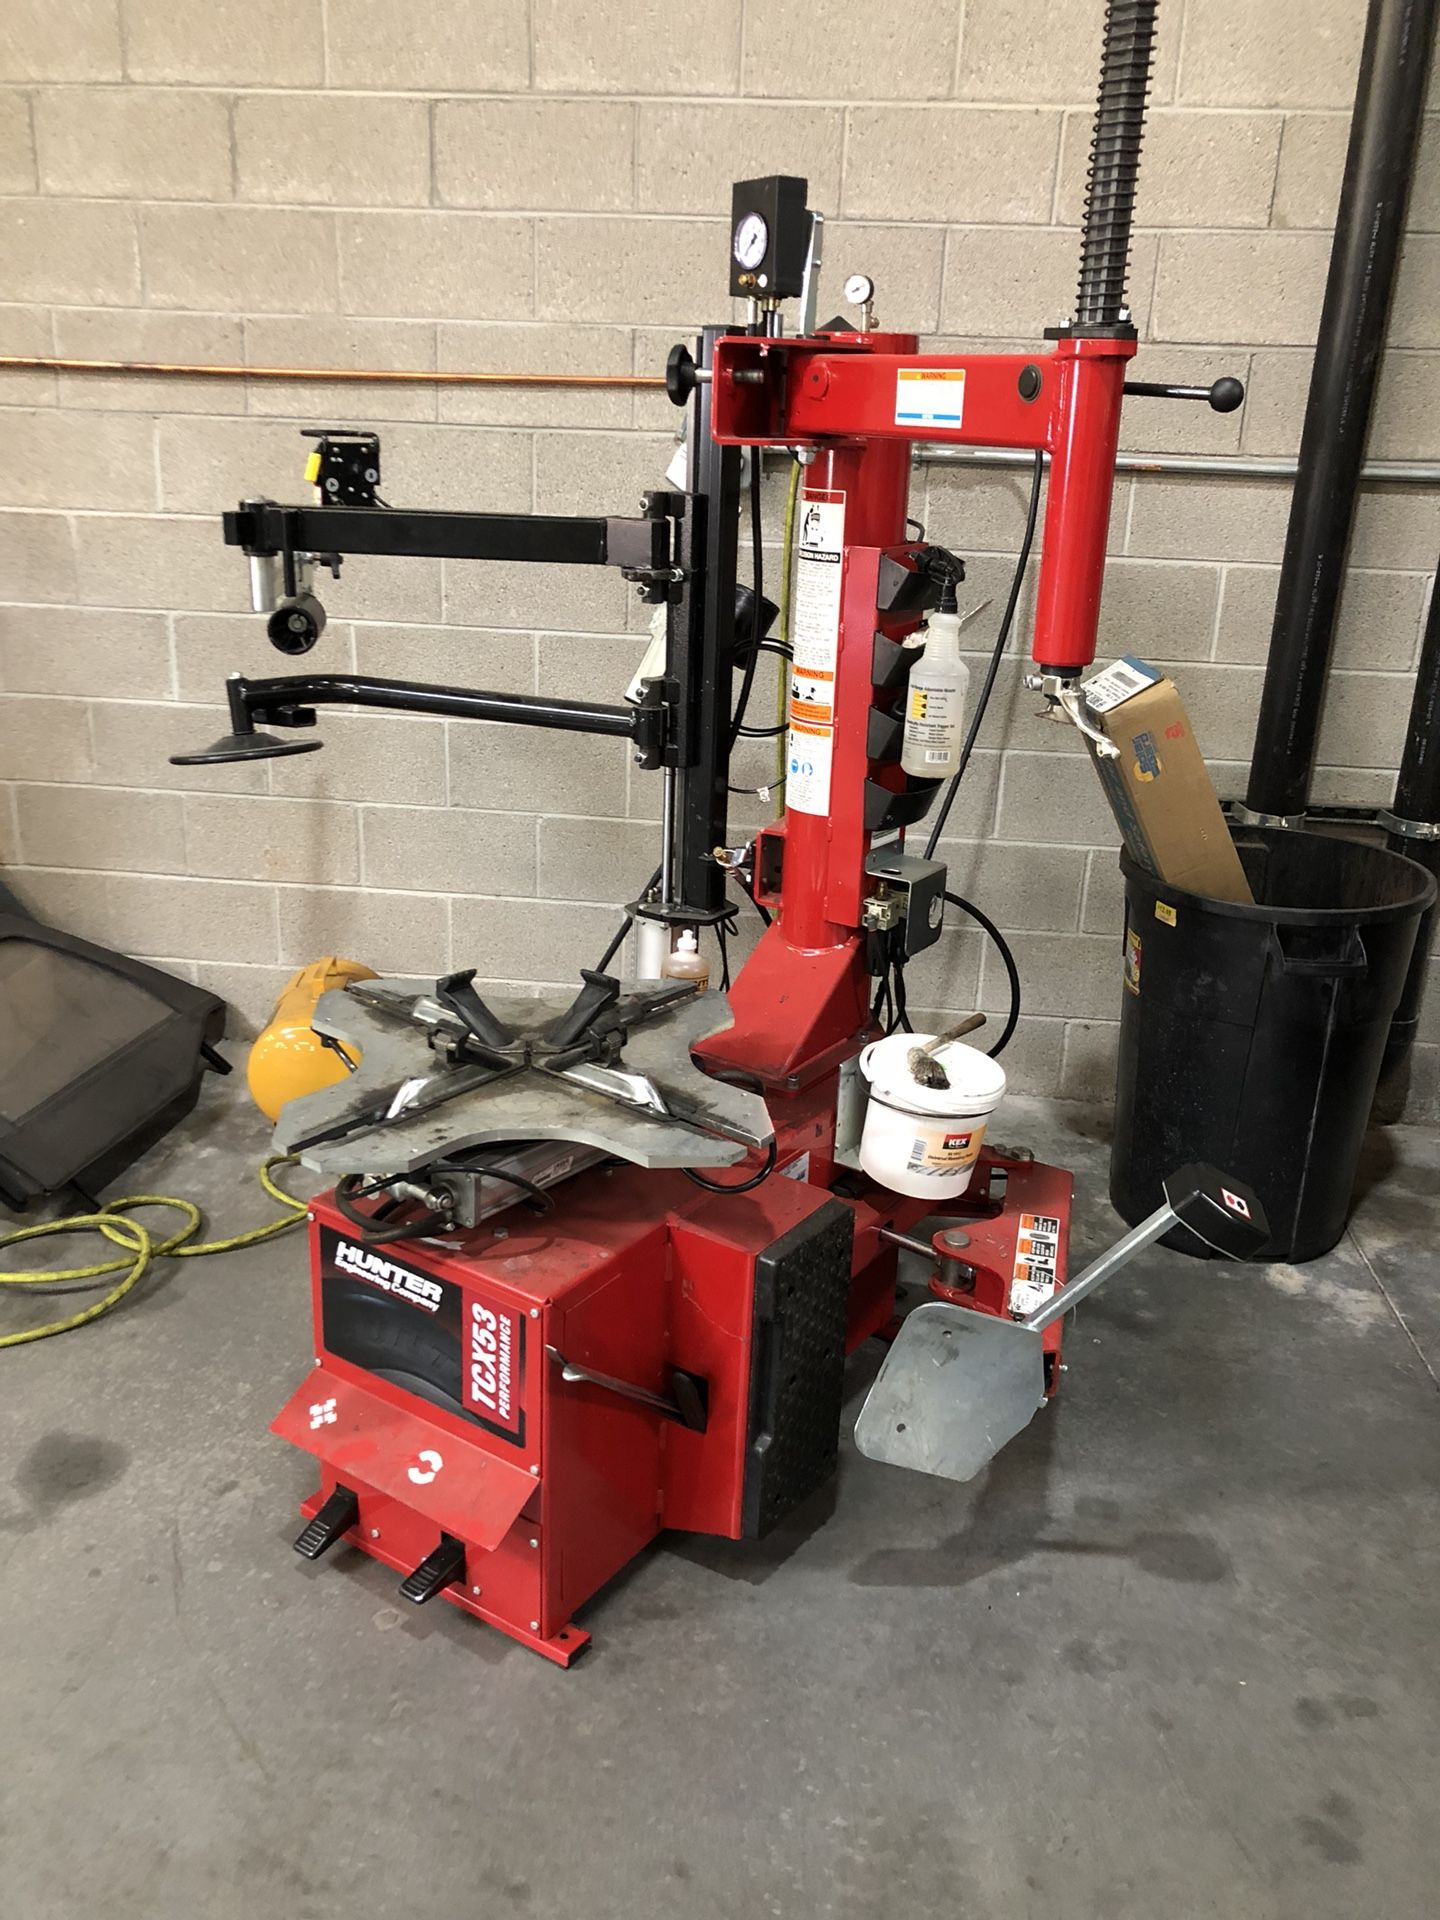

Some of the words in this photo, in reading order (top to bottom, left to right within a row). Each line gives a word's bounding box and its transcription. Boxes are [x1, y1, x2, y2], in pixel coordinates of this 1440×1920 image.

[334, 1255, 391, 1291] Engineering
[391, 1282, 440, 1312] Company
[336, 1241, 443, 1303] HUNTER
[471, 1302, 497, 1410] TCX53
[498, 1313, 512, 1421] PERFORMANCE
